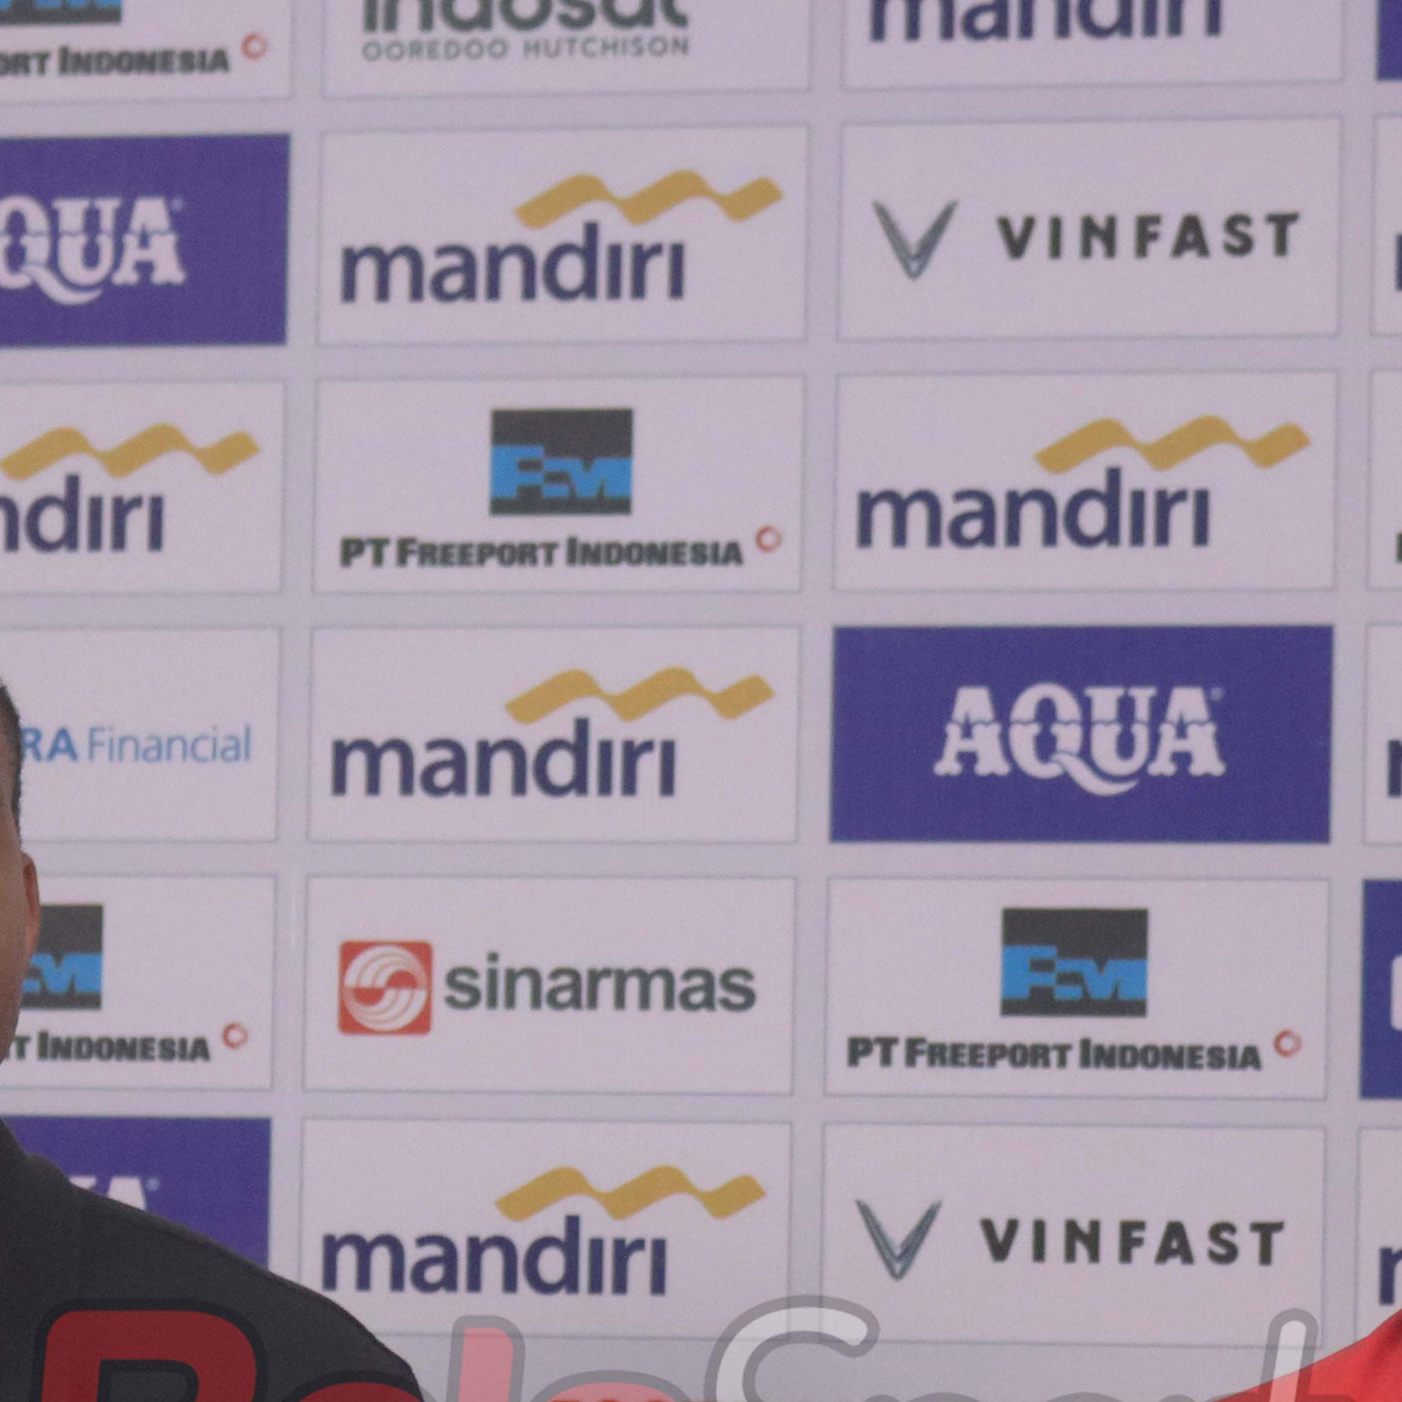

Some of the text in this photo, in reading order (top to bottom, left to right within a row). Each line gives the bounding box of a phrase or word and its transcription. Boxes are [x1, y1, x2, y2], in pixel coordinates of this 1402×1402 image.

[58, 45, 230, 75] INDONESIA
[997, 212, 1300, 260] VINFAST
[341, 221, 685, 303] mandiri
[857, 466, 1210, 549] mandiri
[340, 536, 744, 567] PT FREEPORT INDONESIA
[87, 725, 252, 764] Financial
[332, 717, 676, 798] mandiri
[934, 683, 1225, 796] AQUA
[445, 951, 757, 1013] sinarmas
[37, 1030, 211, 1062] INDONESIA
[847, 1036, 1262, 1071] PT FREEPORT INDONESIA
[322, 1214, 667, 1297] mandiri
[980, 1218, 1285, 1266] VINFAST
